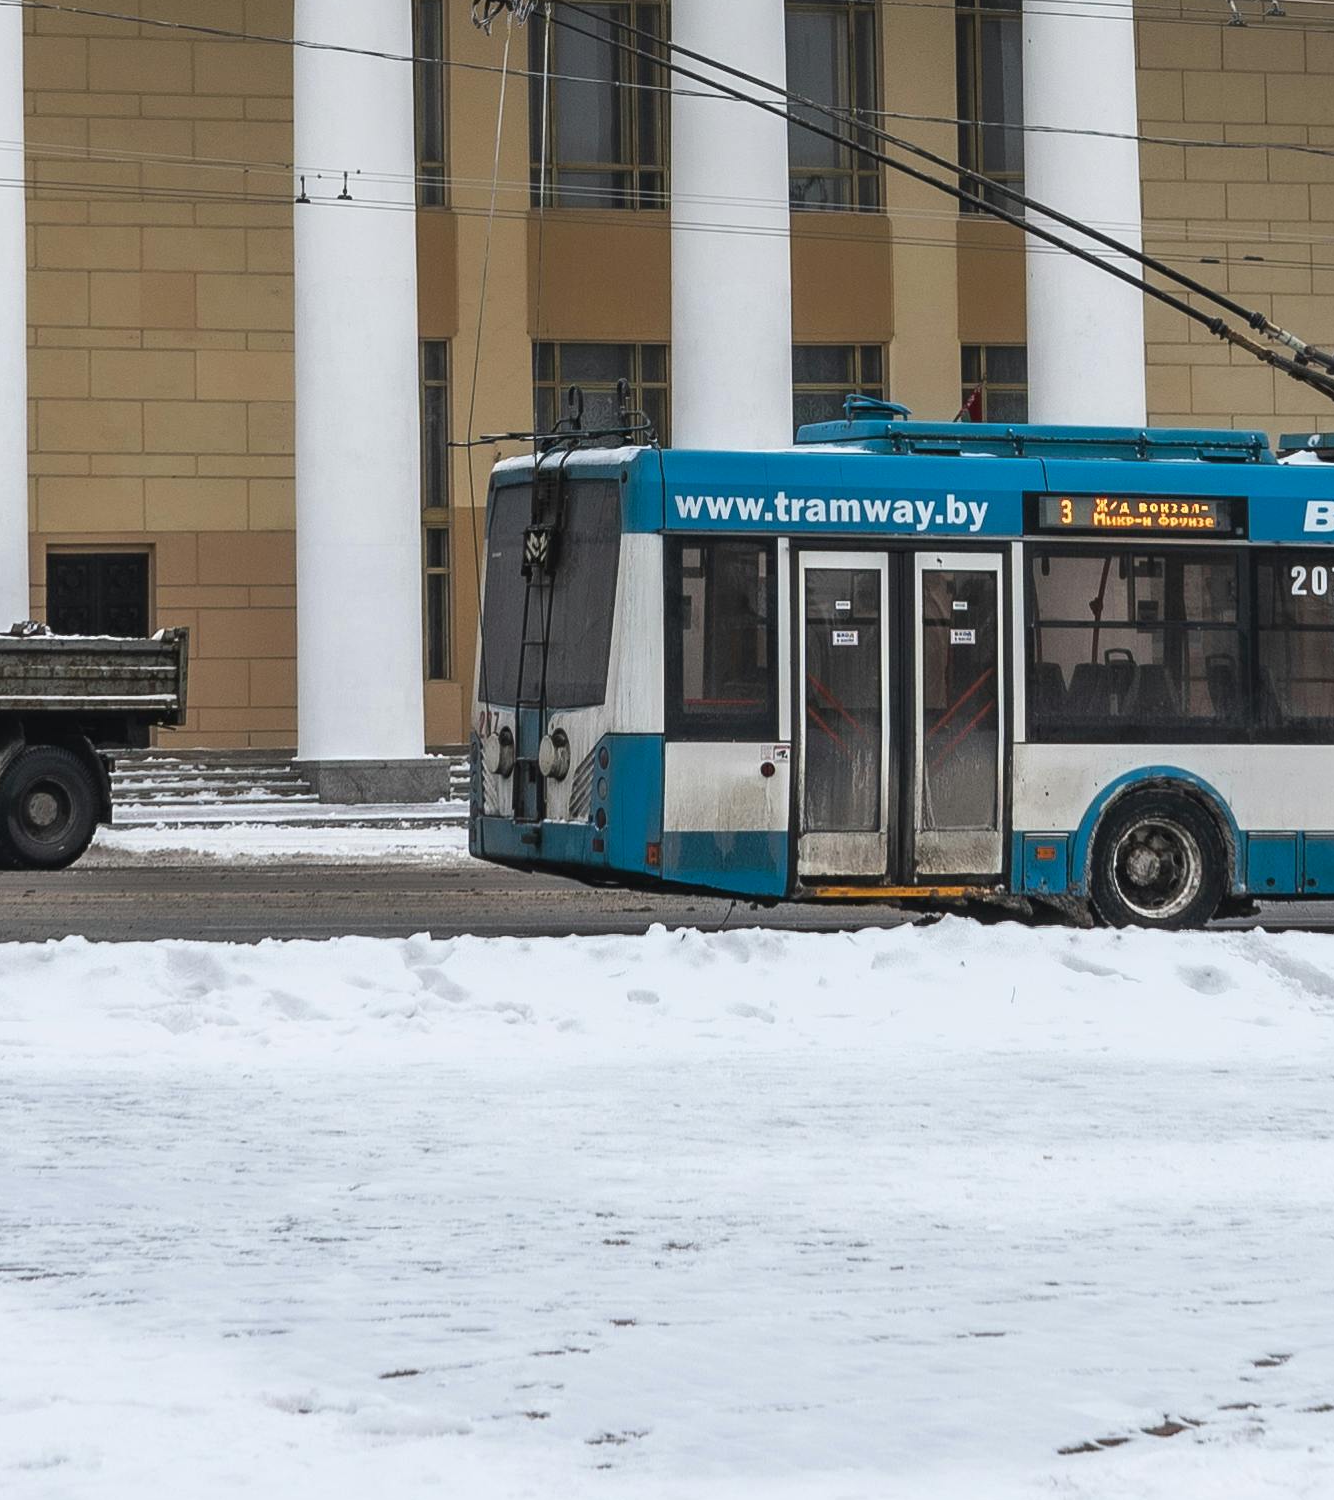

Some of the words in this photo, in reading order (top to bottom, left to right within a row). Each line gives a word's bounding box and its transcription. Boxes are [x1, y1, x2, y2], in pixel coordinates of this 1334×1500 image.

[674, 490, 988, 532] www.tramway.by
[1061, 498, 1073, 525] 3
[1095, 498, 1131, 514] Ж/д
[1093, 513, 1152, 527] Микр-н
[1158, 513, 1215, 528] Фрунзе
